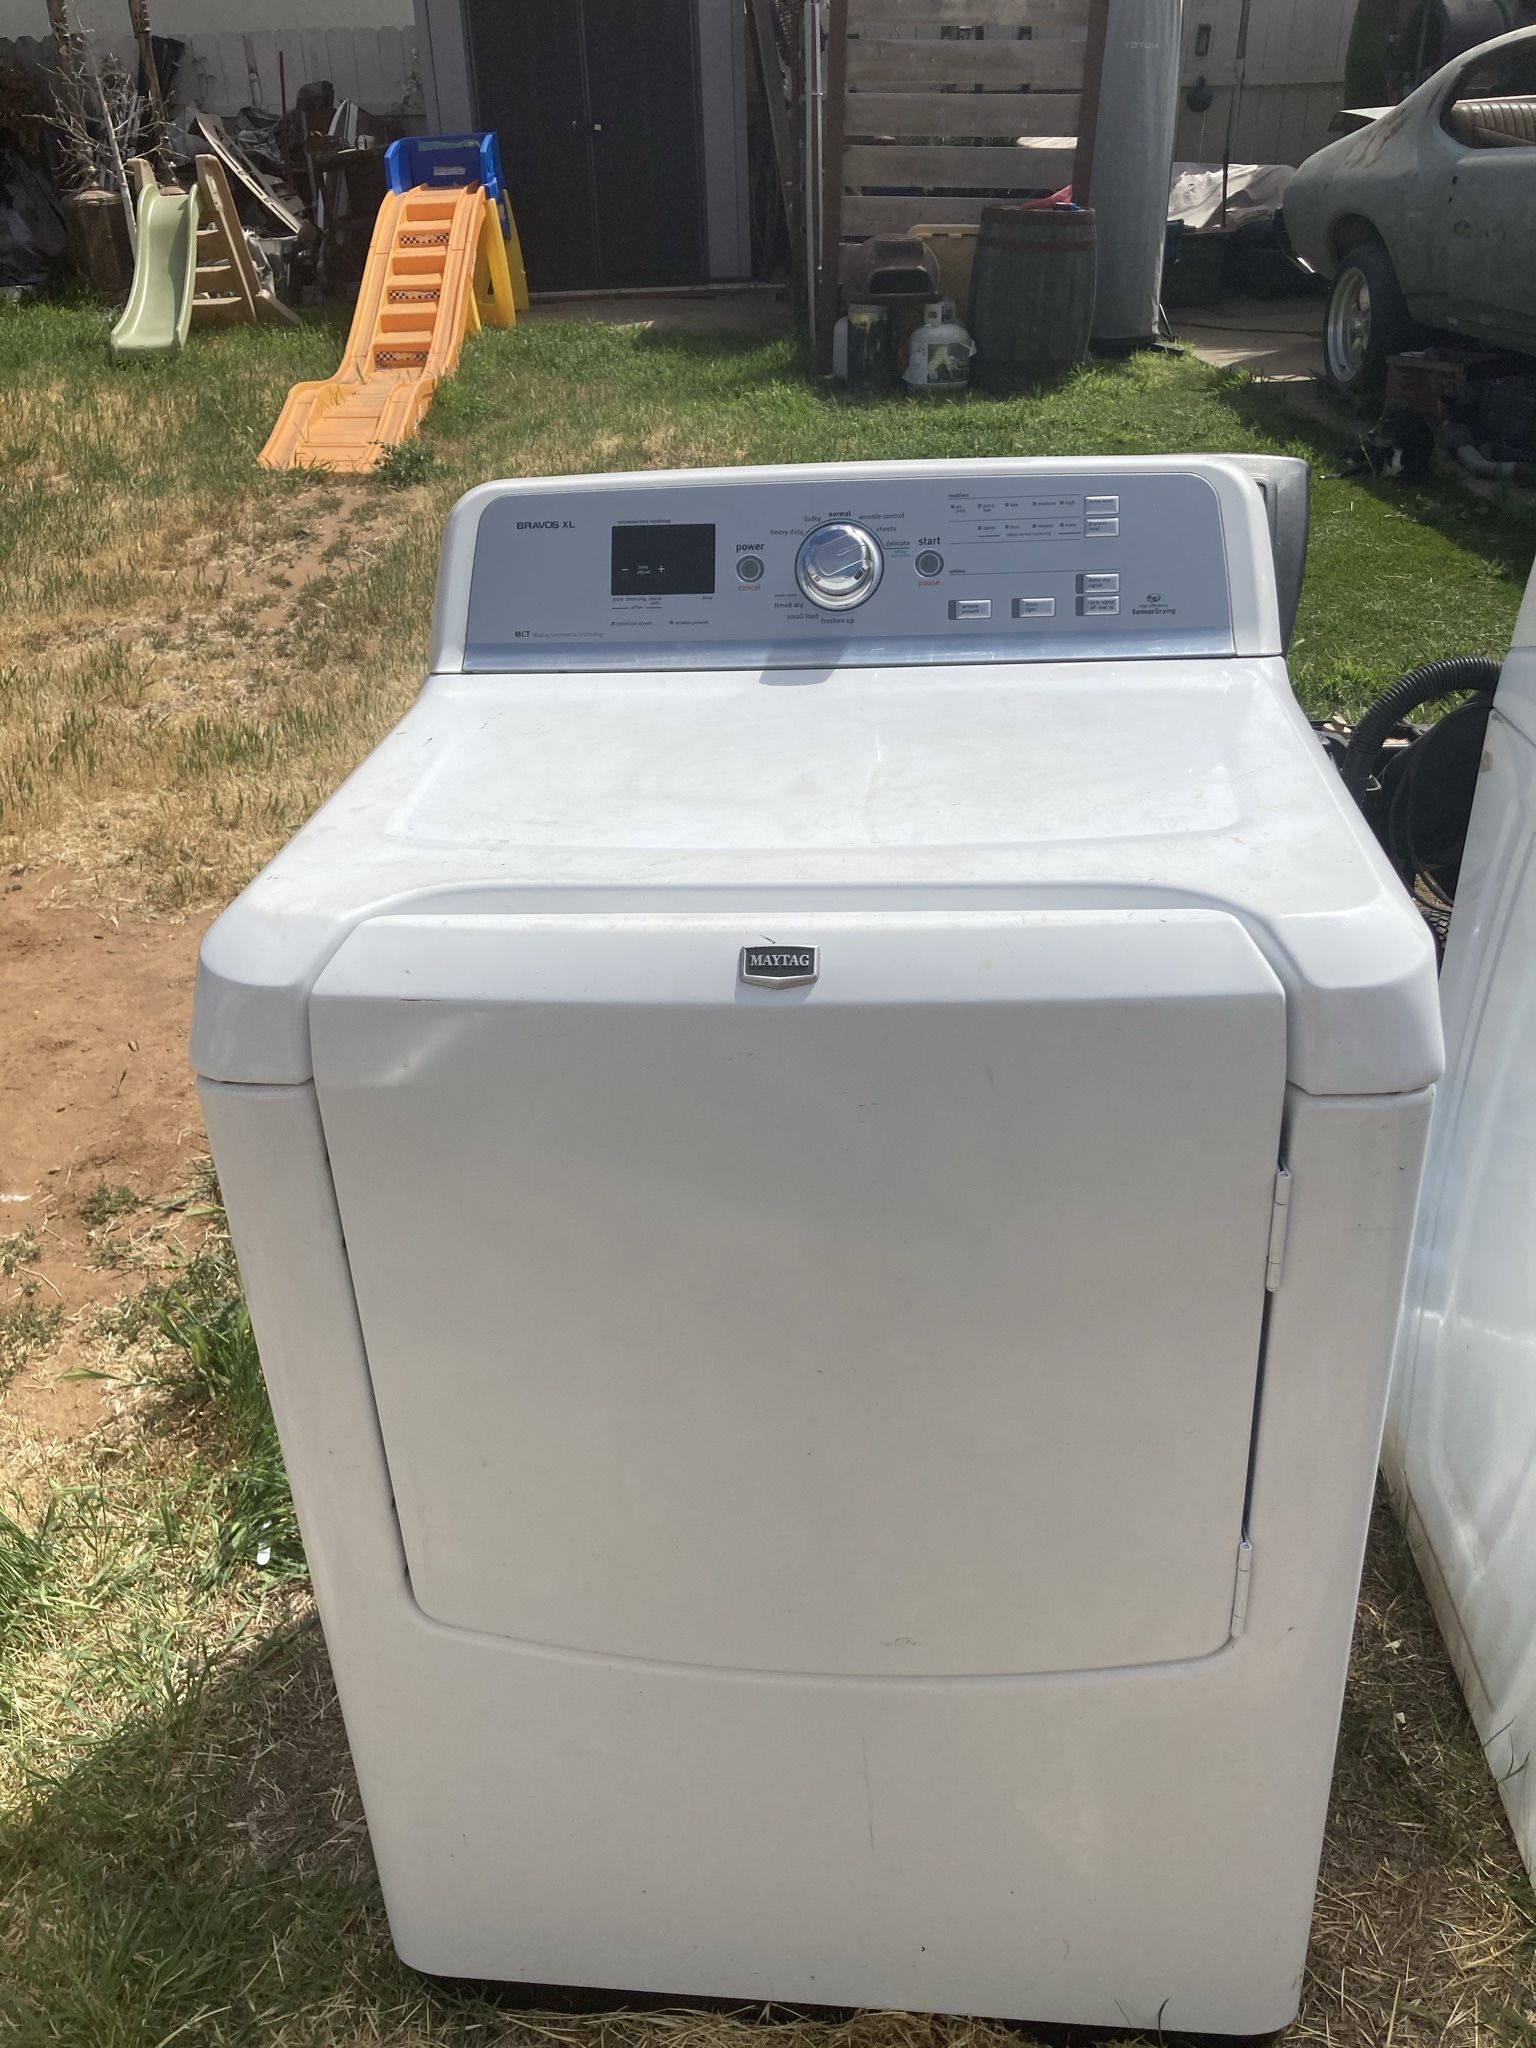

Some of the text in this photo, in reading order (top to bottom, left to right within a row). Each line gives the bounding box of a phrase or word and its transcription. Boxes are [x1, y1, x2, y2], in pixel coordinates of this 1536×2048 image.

[828, 510, 851, 518] normal
[858, 512, 906, 521] wrinkle control
[516, 520, 576, 530] BRAVOS XL
[875, 525, 897, 533] sheets
[789, 528, 804, 536] duty
[918, 536, 942, 546] start
[735, 542, 765, 553] power
[918, 579, 941, 588] pause
[737, 584, 762, 592] cancel
[787, 612, 819, 620] small load
[514, 630, 531, 638] MCT
[750, 954, 809, 967] MAYTAG
